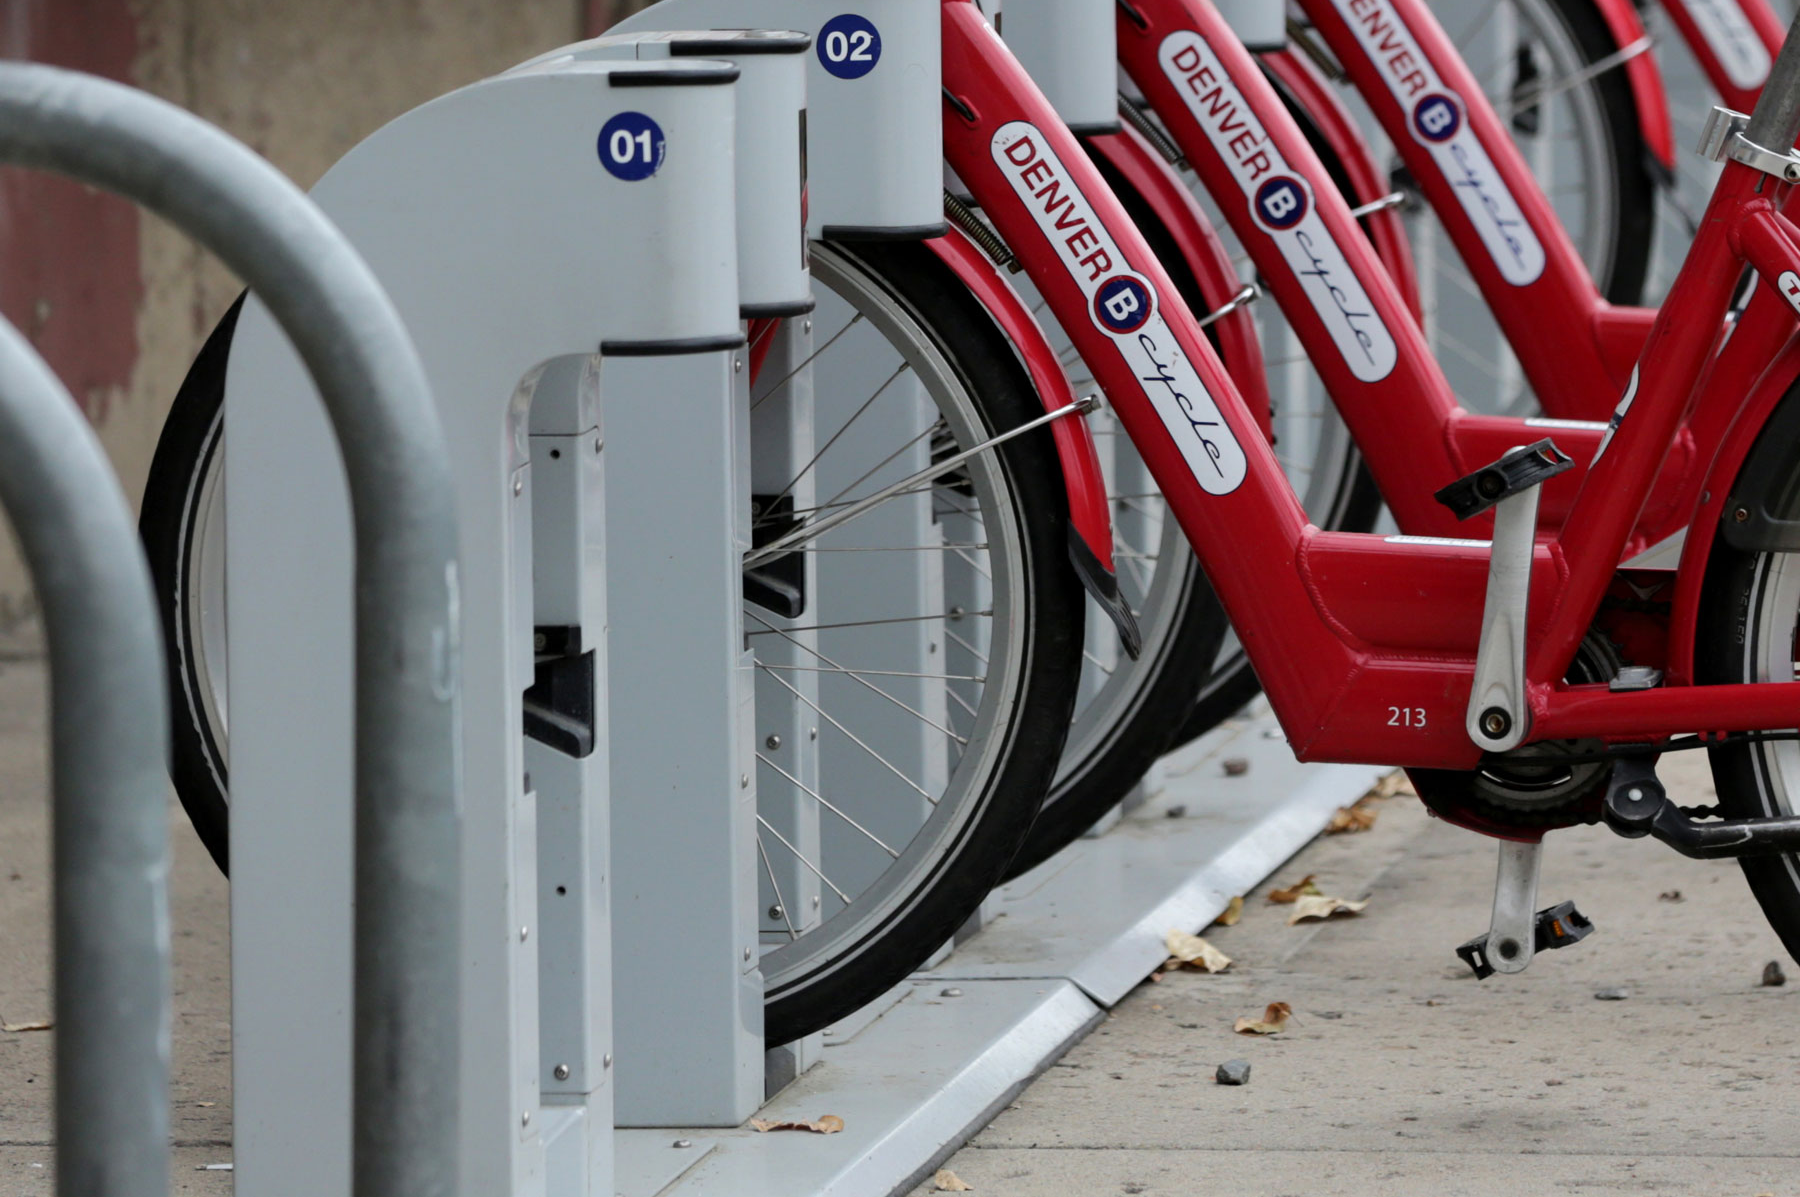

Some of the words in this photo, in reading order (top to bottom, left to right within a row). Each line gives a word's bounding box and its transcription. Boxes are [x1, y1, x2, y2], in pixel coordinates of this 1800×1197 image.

[825, 30, 874, 63] 02
[609, 129, 653, 164] 01
[1171, 45, 1272, 181] DENVER
[1295, 230, 1376, 367] cycle
[1004, 136, 1113, 282] DENVER
[1138, 332, 1225, 479] cycle
[1387, 706, 1426, 728] 213
